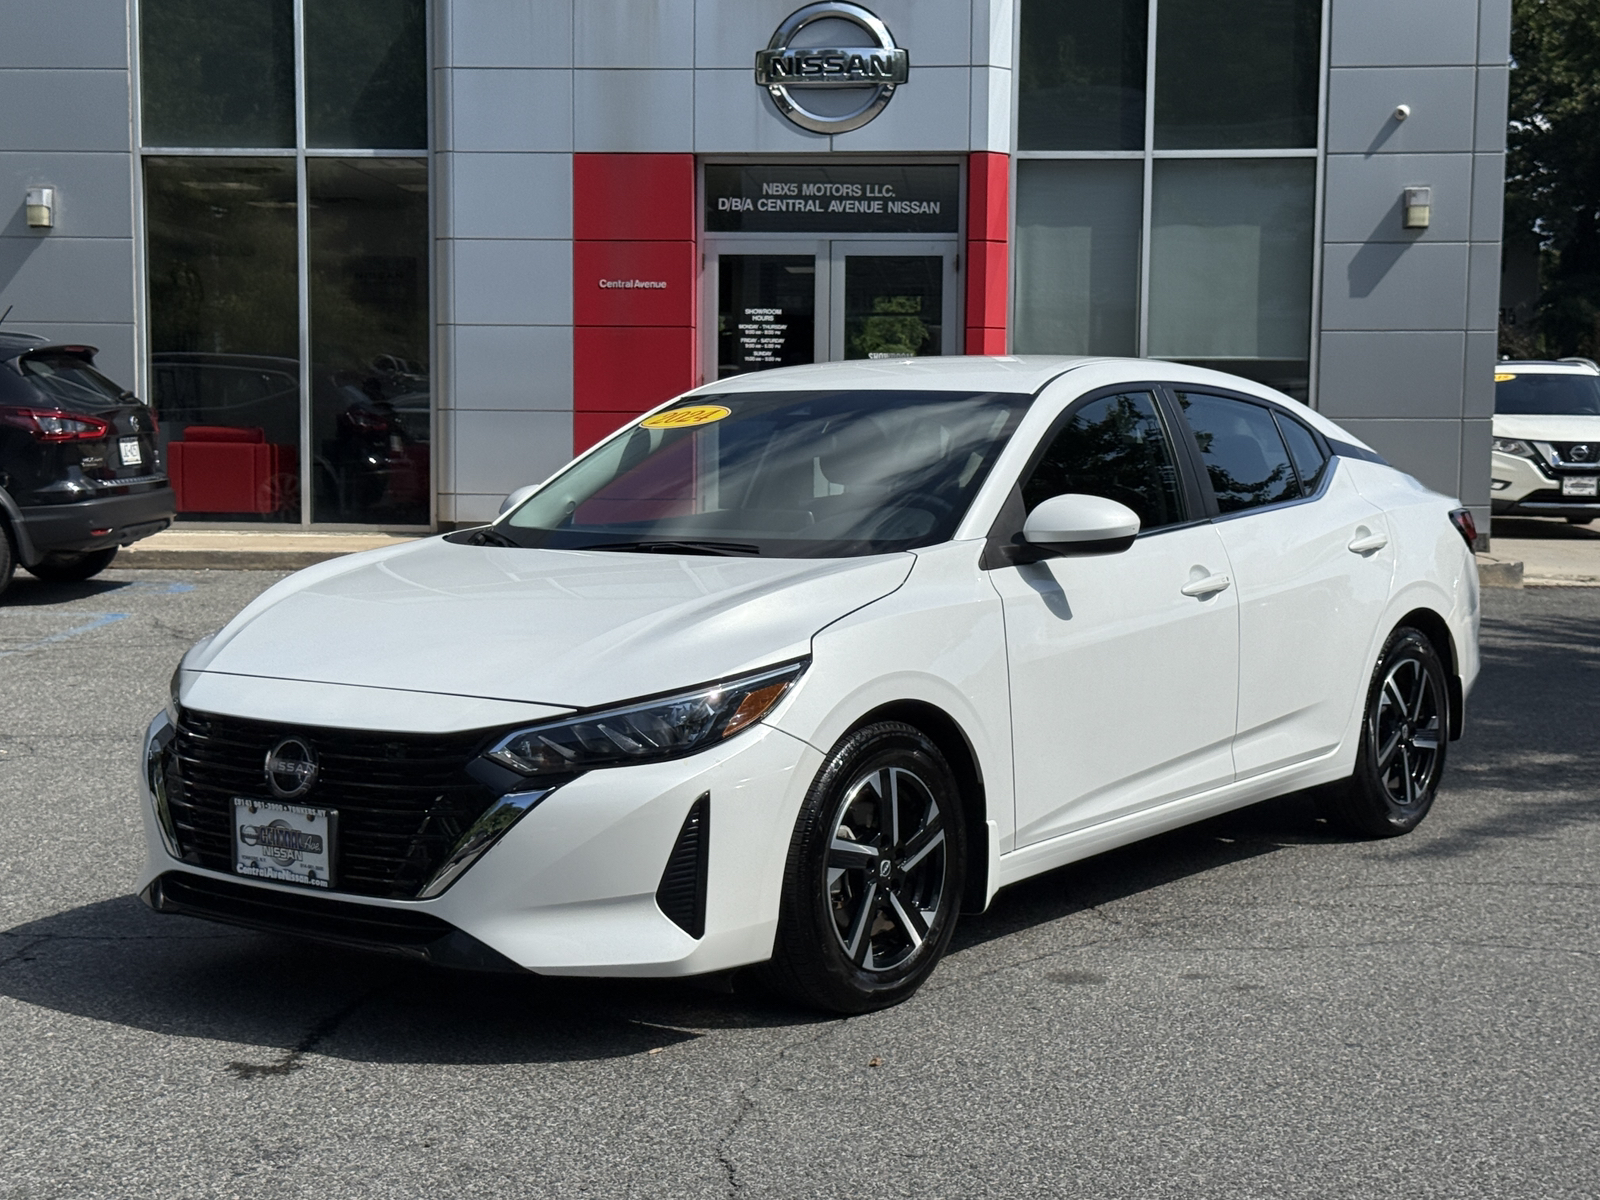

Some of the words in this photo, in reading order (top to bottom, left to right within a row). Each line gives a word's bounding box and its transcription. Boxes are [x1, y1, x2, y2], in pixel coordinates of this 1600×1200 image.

[770, 54, 893, 77] NISSAN
[762, 183, 798, 195] NBX5
[802, 183, 862, 197] MOTORS
[866, 184, 896, 197] LLC.
[718, 197, 754, 212] D/B/A
[757, 198, 824, 212] CENTRAL
[828, 200, 883, 213] AVENUE
[888, 201, 940, 214] NISSAN
[599, 279, 633, 289] Central
[634, 279, 667, 289] Avenue
[648, 409, 721, 425] 2024
[262, 845, 304, 861] NISSAN
